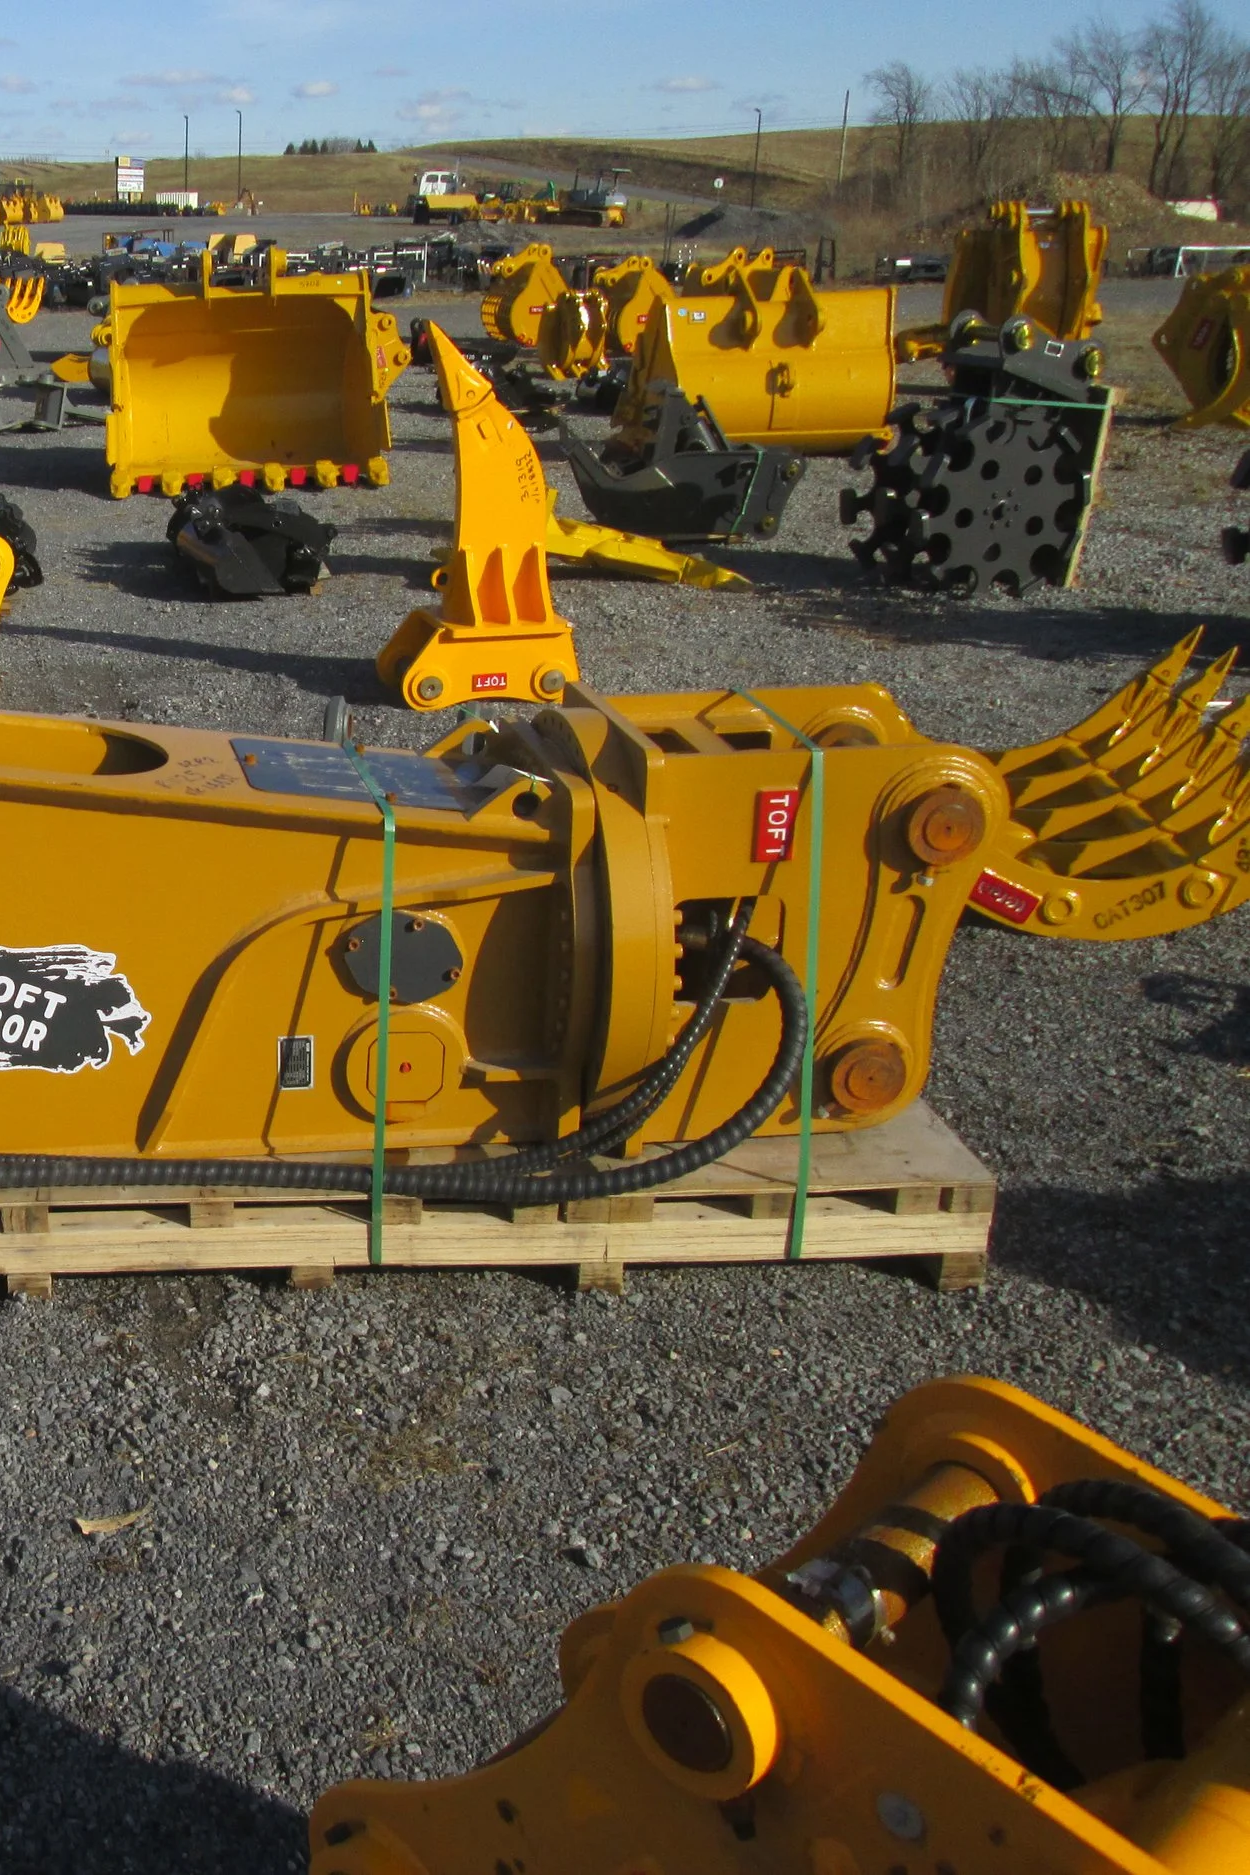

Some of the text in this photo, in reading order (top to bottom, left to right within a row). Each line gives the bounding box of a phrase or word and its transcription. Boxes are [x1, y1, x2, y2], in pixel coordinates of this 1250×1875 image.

[475, 675, 507, 688] TOFT
[765, 794, 790, 857] TOFT
[1092, 880, 1167, 930] CAT307
